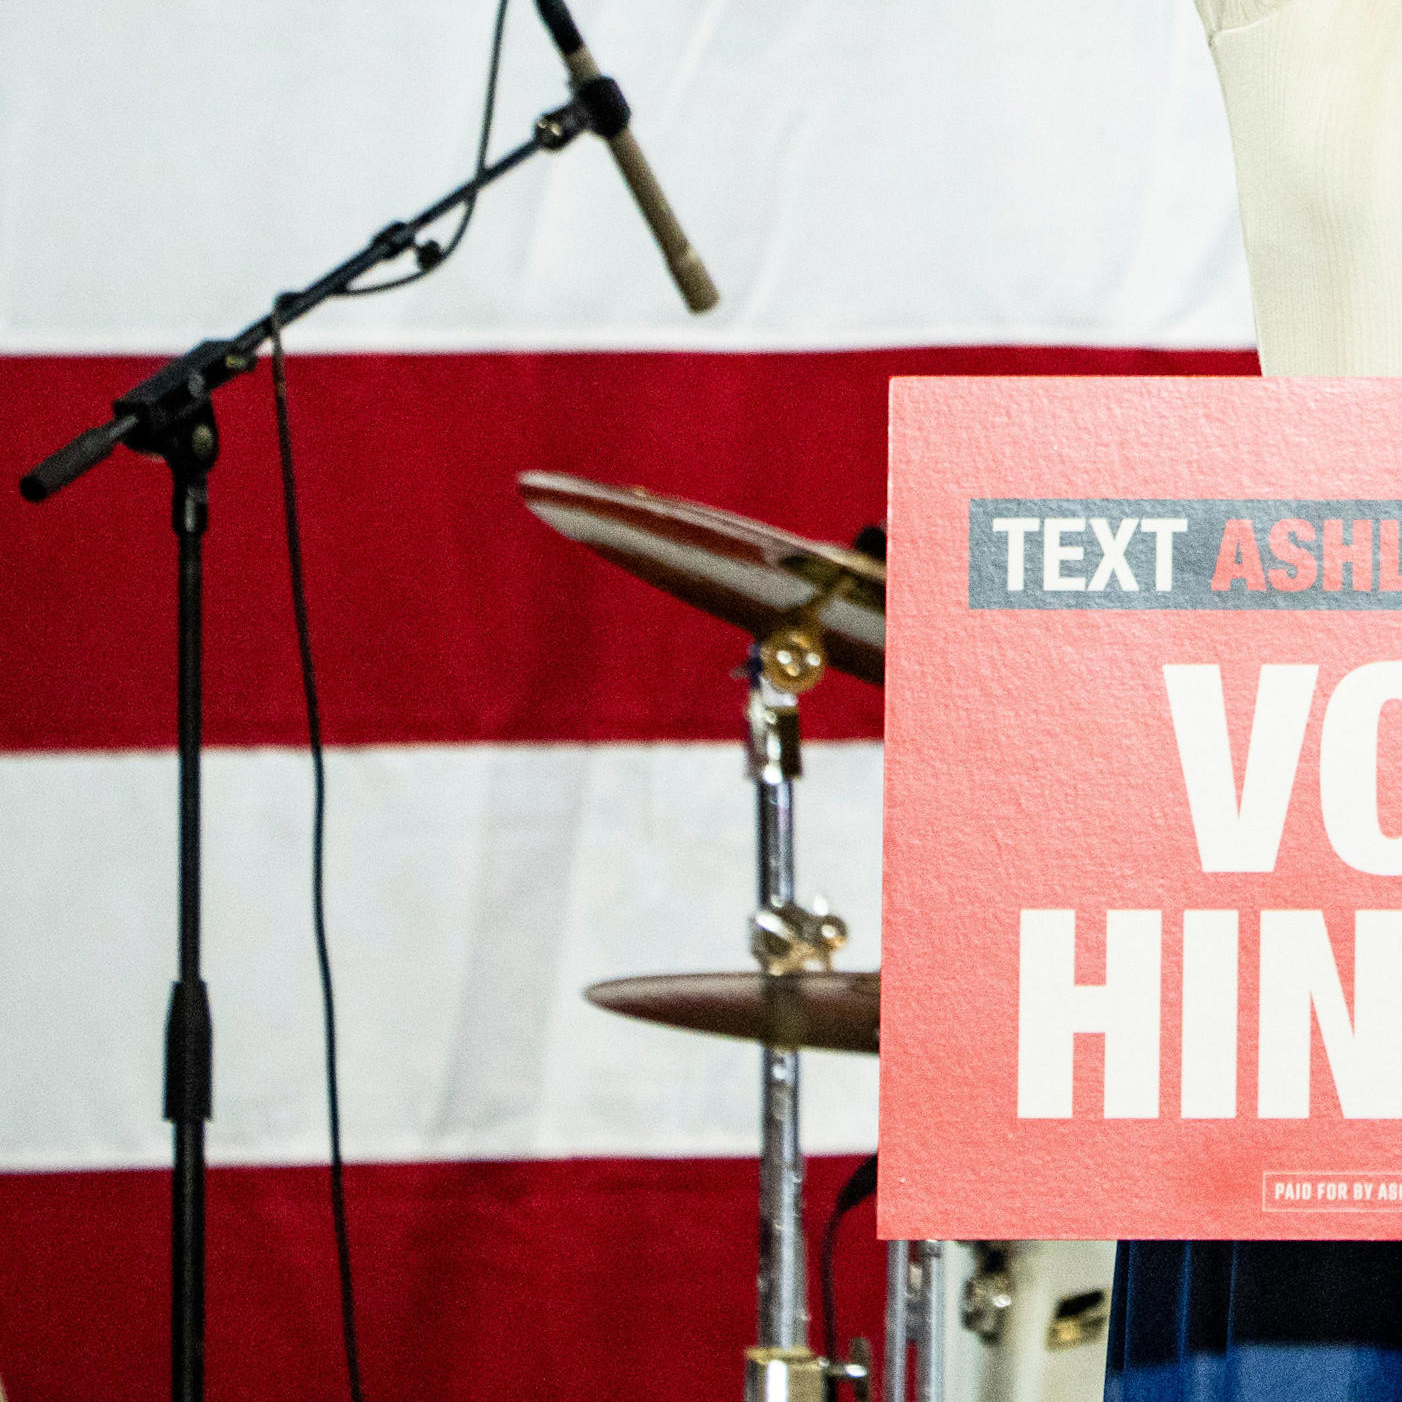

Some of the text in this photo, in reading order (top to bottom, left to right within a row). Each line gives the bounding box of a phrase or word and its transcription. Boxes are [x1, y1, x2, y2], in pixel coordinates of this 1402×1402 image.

[992, 517, 1188, 592] TEXT
[1275, 1182, 1312, 1200] PAID
[1317, 1182, 1348, 1200] FOR
[1353, 1182, 1373, 1200] BY
